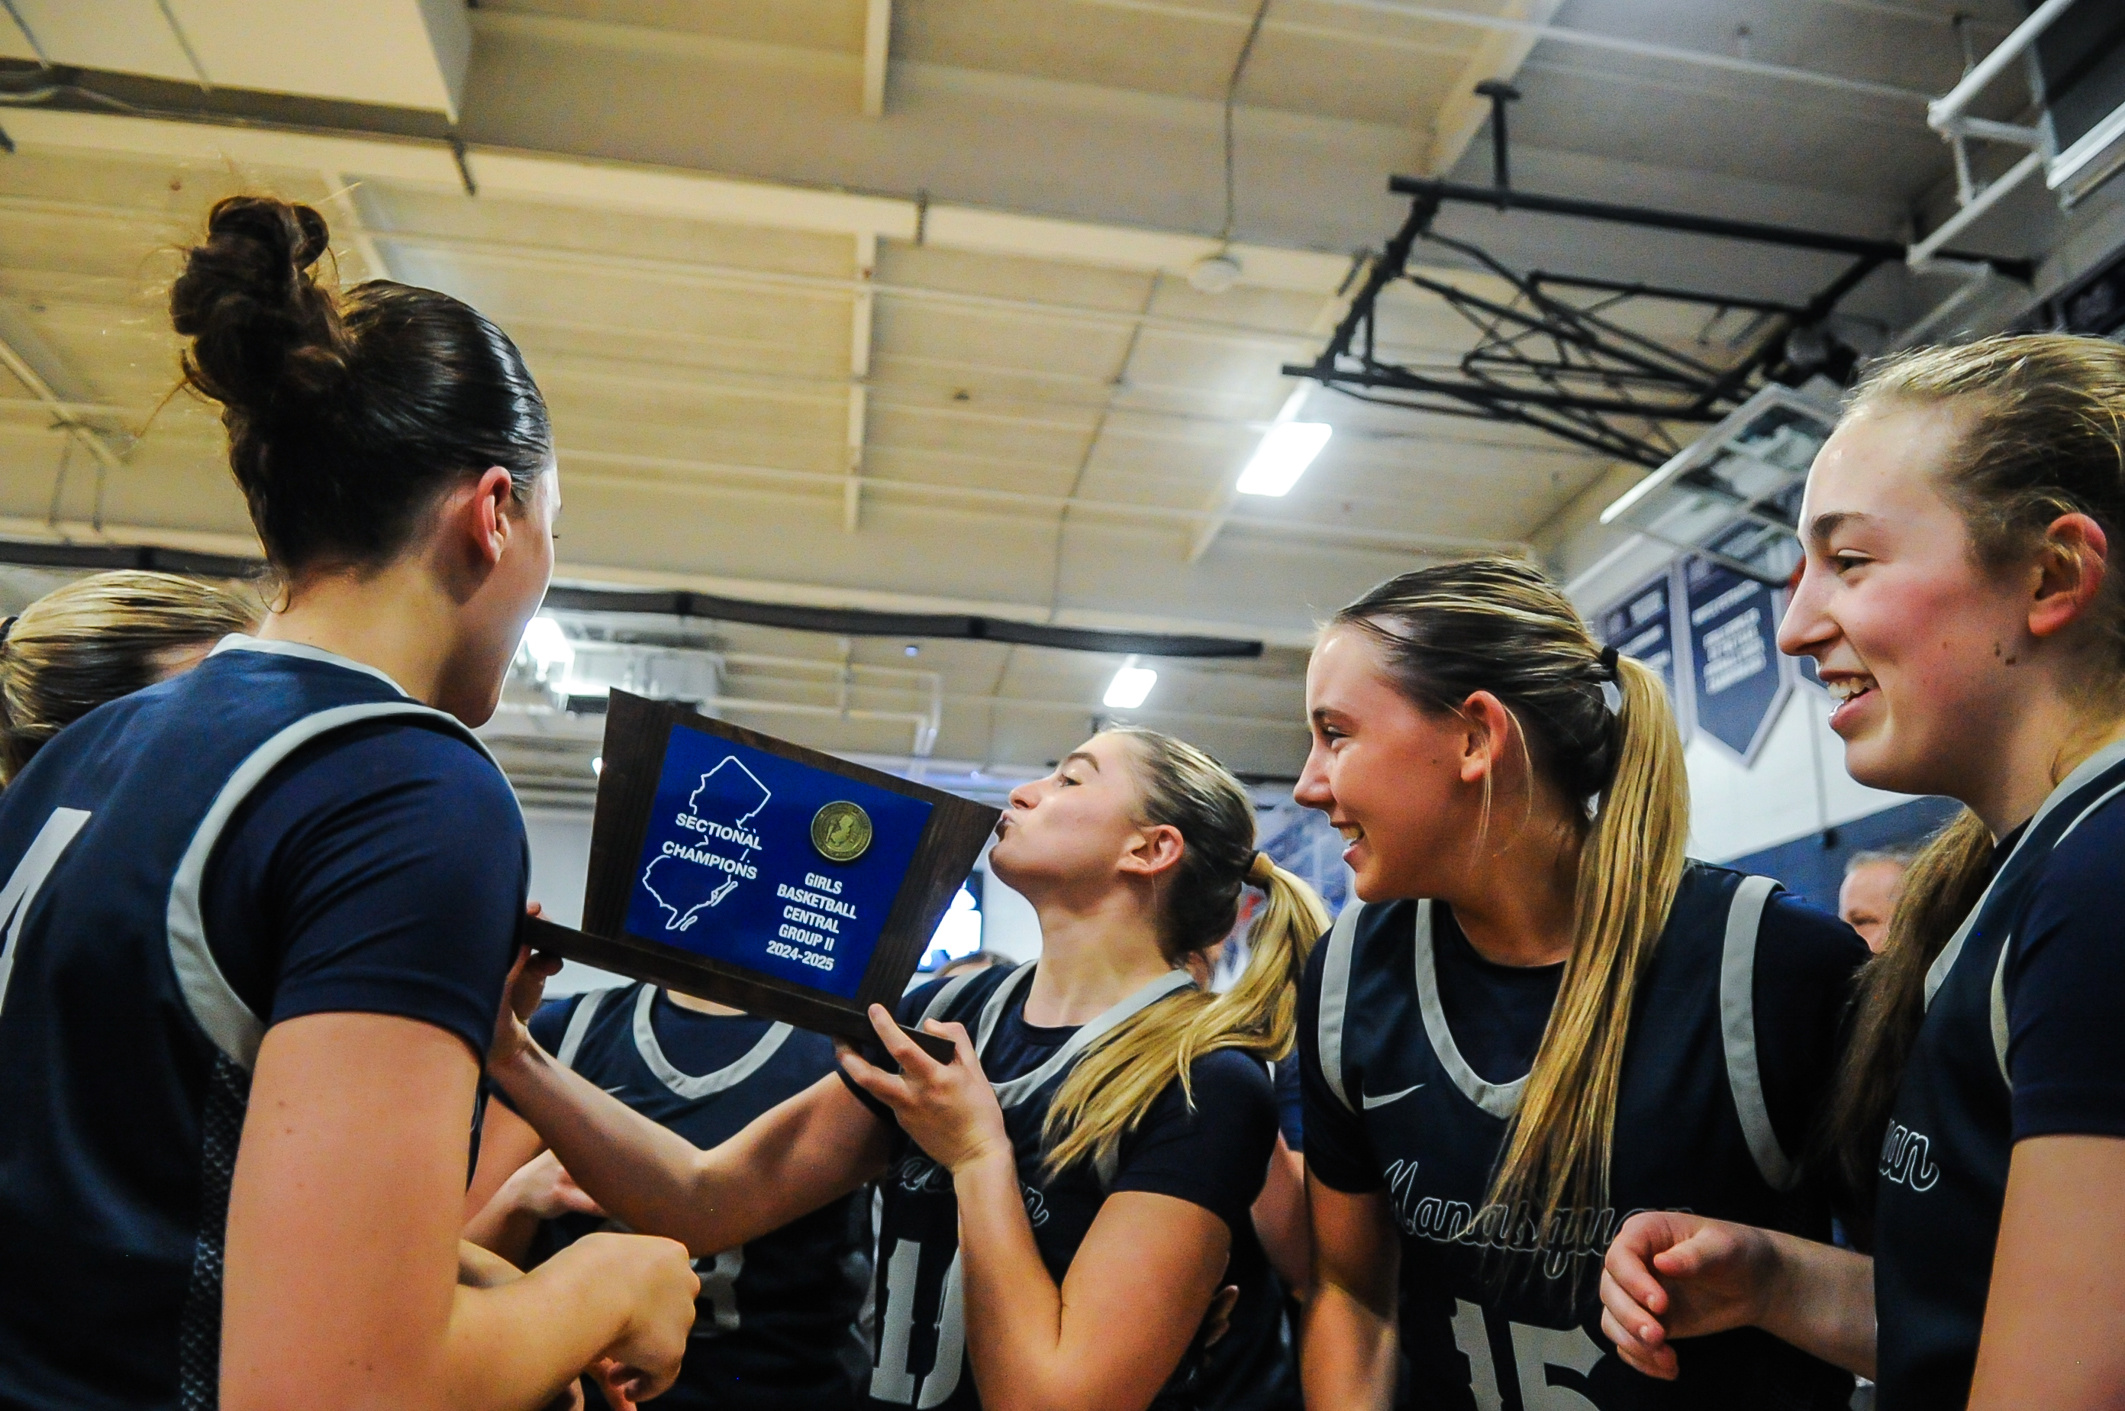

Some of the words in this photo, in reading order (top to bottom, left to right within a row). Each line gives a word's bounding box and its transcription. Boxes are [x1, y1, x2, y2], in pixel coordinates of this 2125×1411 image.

[675, 813, 762, 851] SECTIONAL
[662, 841, 758, 880] CHAMPIONS
[804, 872, 843, 895] GIRLS
[776, 883, 857, 920] BASKETBALL
[783, 905, 840, 934] CENTRAL
[778, 923, 823, 947] GROUP
[823, 937, 835, 951] II
[766, 940, 835, 971] 2024-2025
